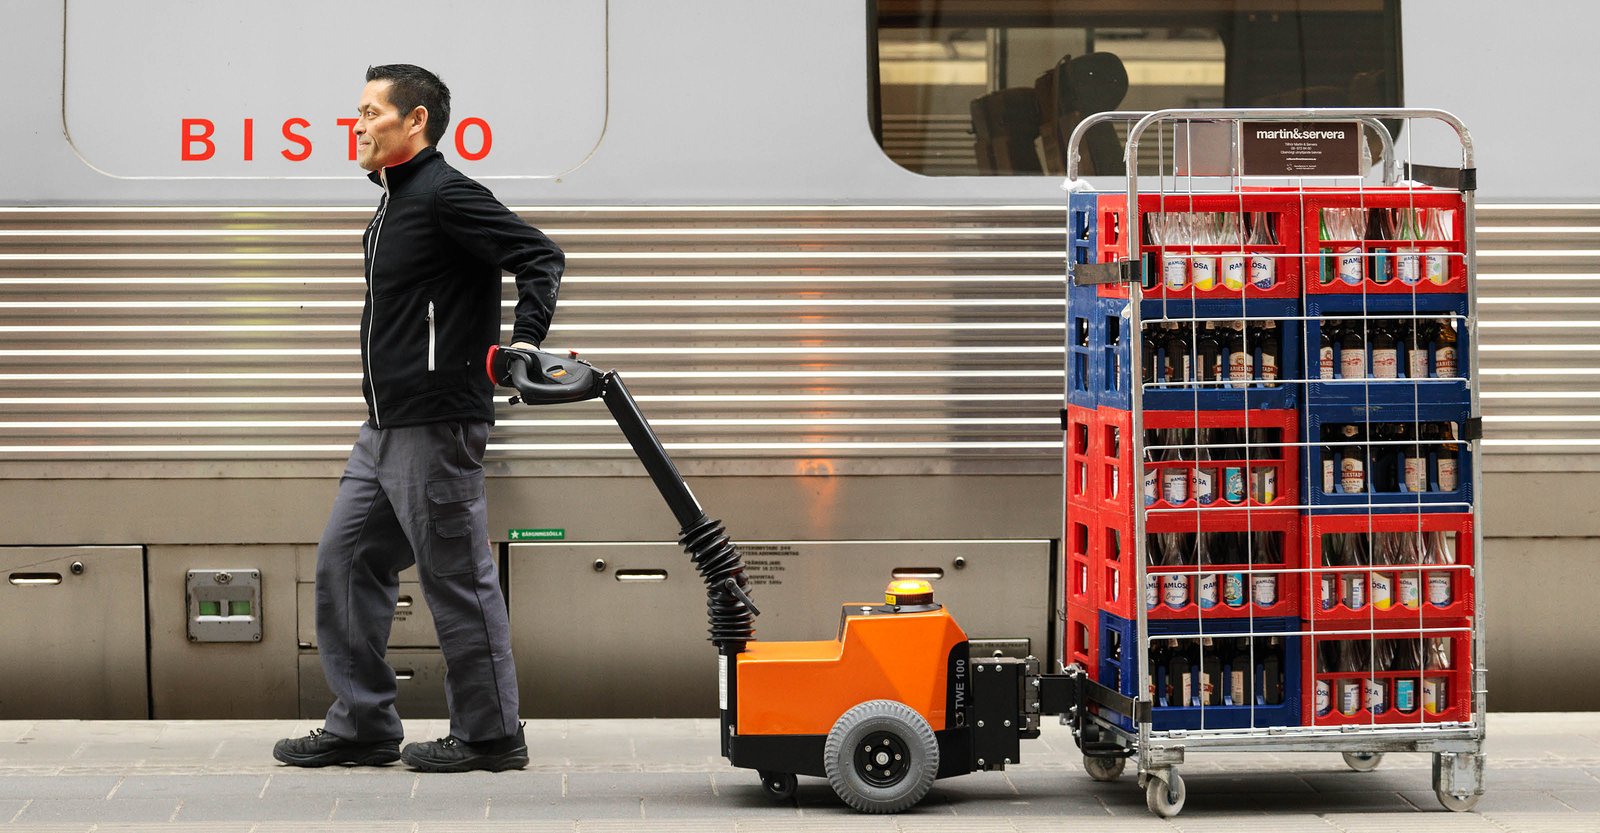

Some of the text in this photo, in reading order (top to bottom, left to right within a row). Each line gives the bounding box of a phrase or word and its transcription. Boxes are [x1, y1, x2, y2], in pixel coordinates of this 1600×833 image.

[181, 117, 494, 161] BISTO
[1256, 128, 1345, 139] martin&servera
[955, 659, 965, 709] TWE 100
